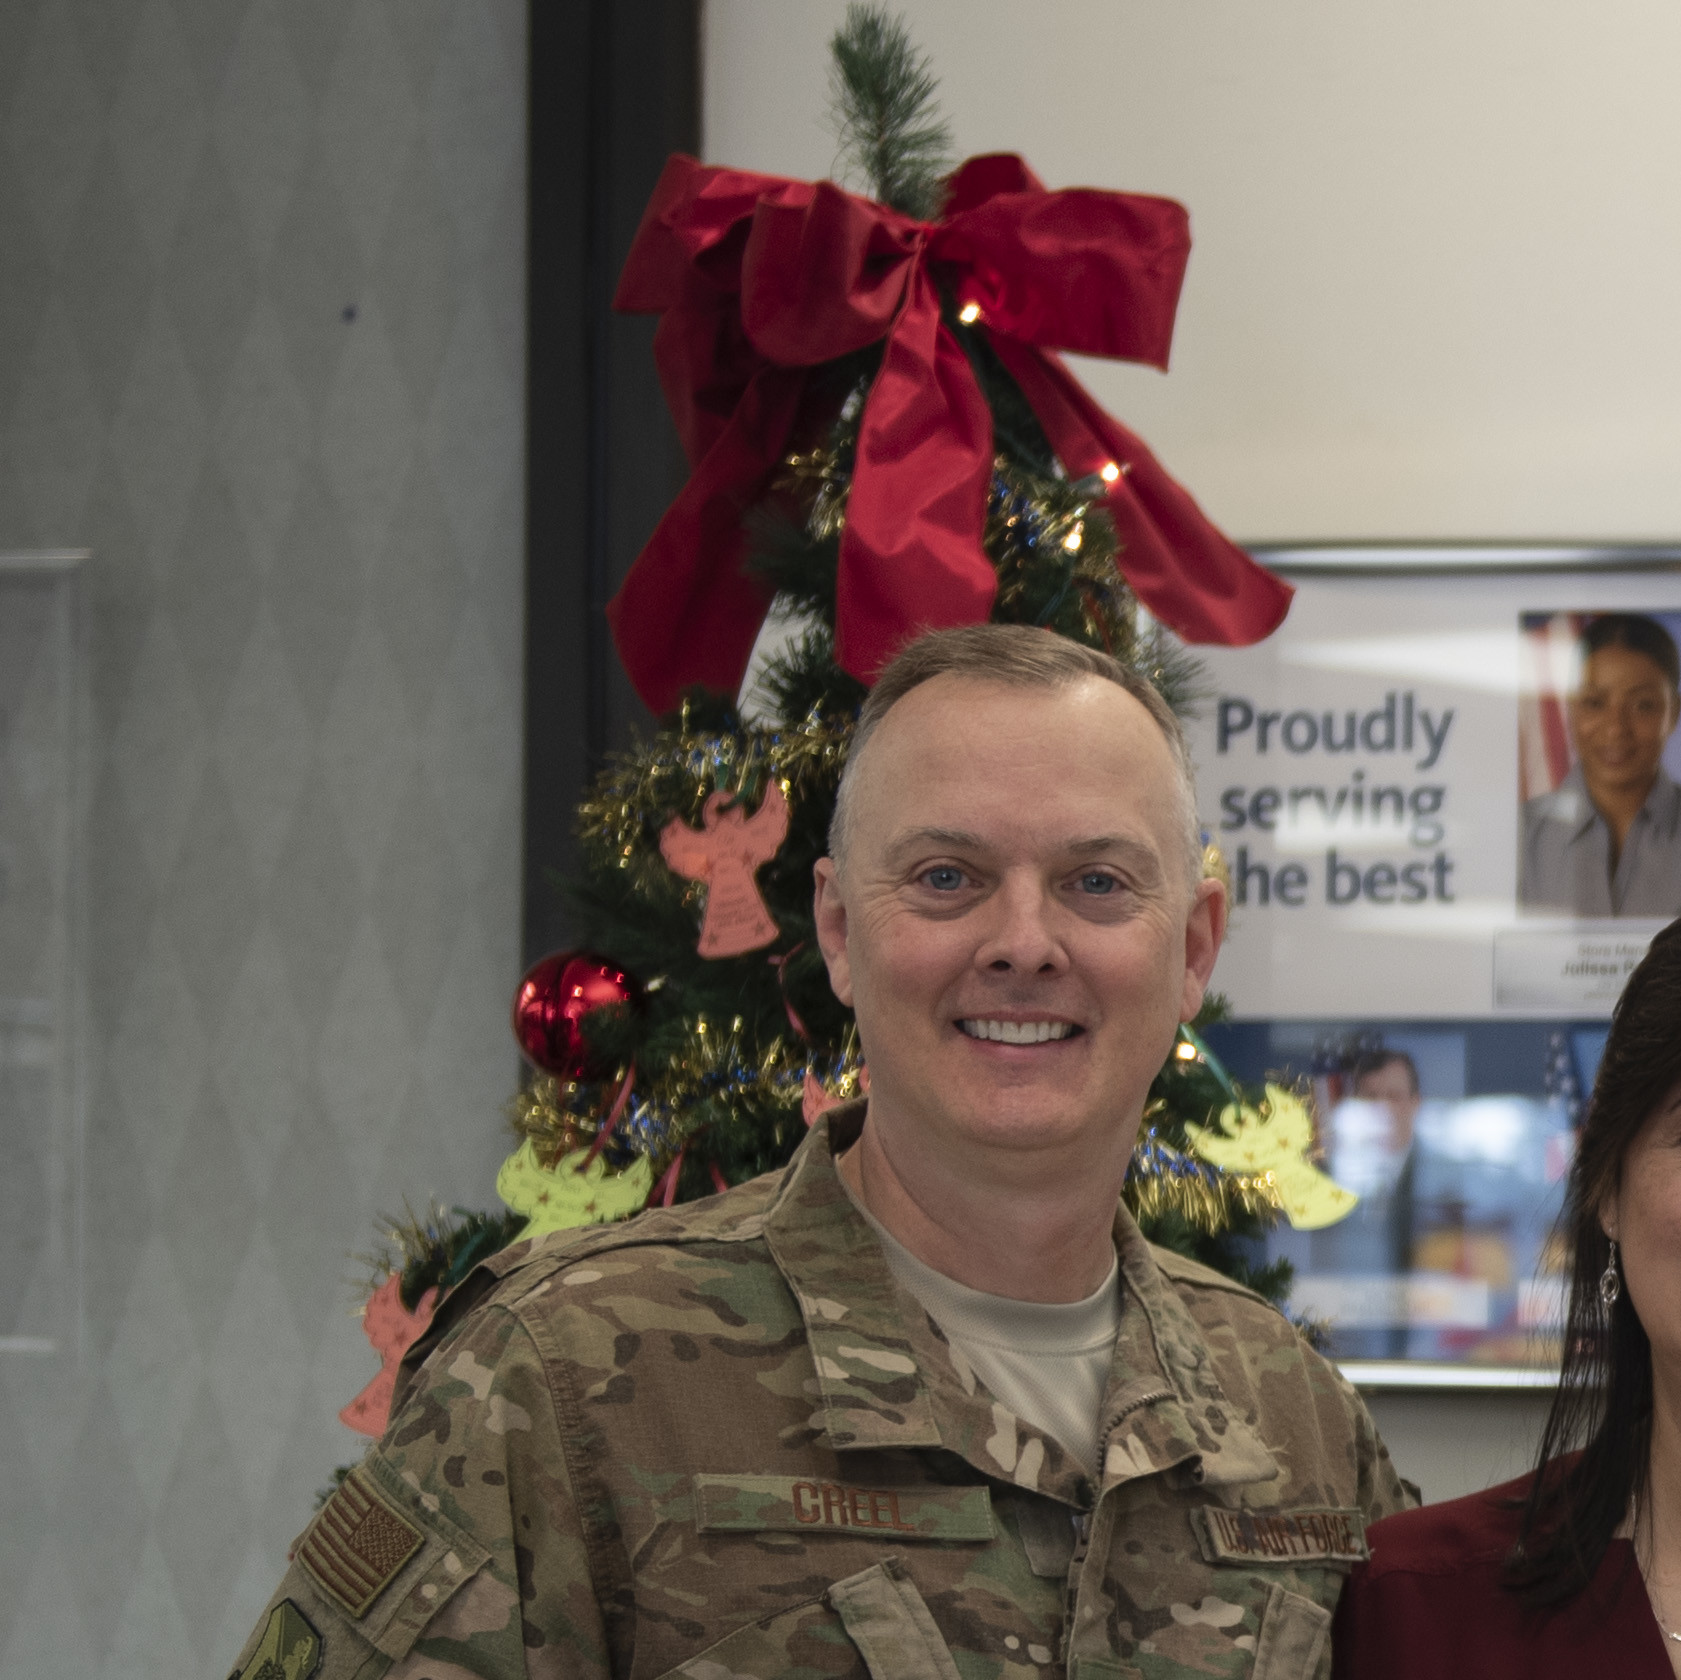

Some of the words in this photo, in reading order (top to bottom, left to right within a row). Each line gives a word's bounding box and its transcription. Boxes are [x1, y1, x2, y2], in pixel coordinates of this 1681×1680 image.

[1217, 691, 1454, 770] Proudly
[1220, 769, 1446, 847] serving
[1235, 846, 1308, 906] he
[1326, 846, 1454, 905] best
[792, 1481, 915, 1531] CREEL
[1252, 1515, 1297, 1555] AIR
[1294, 1513, 1356, 1553] FORCE
